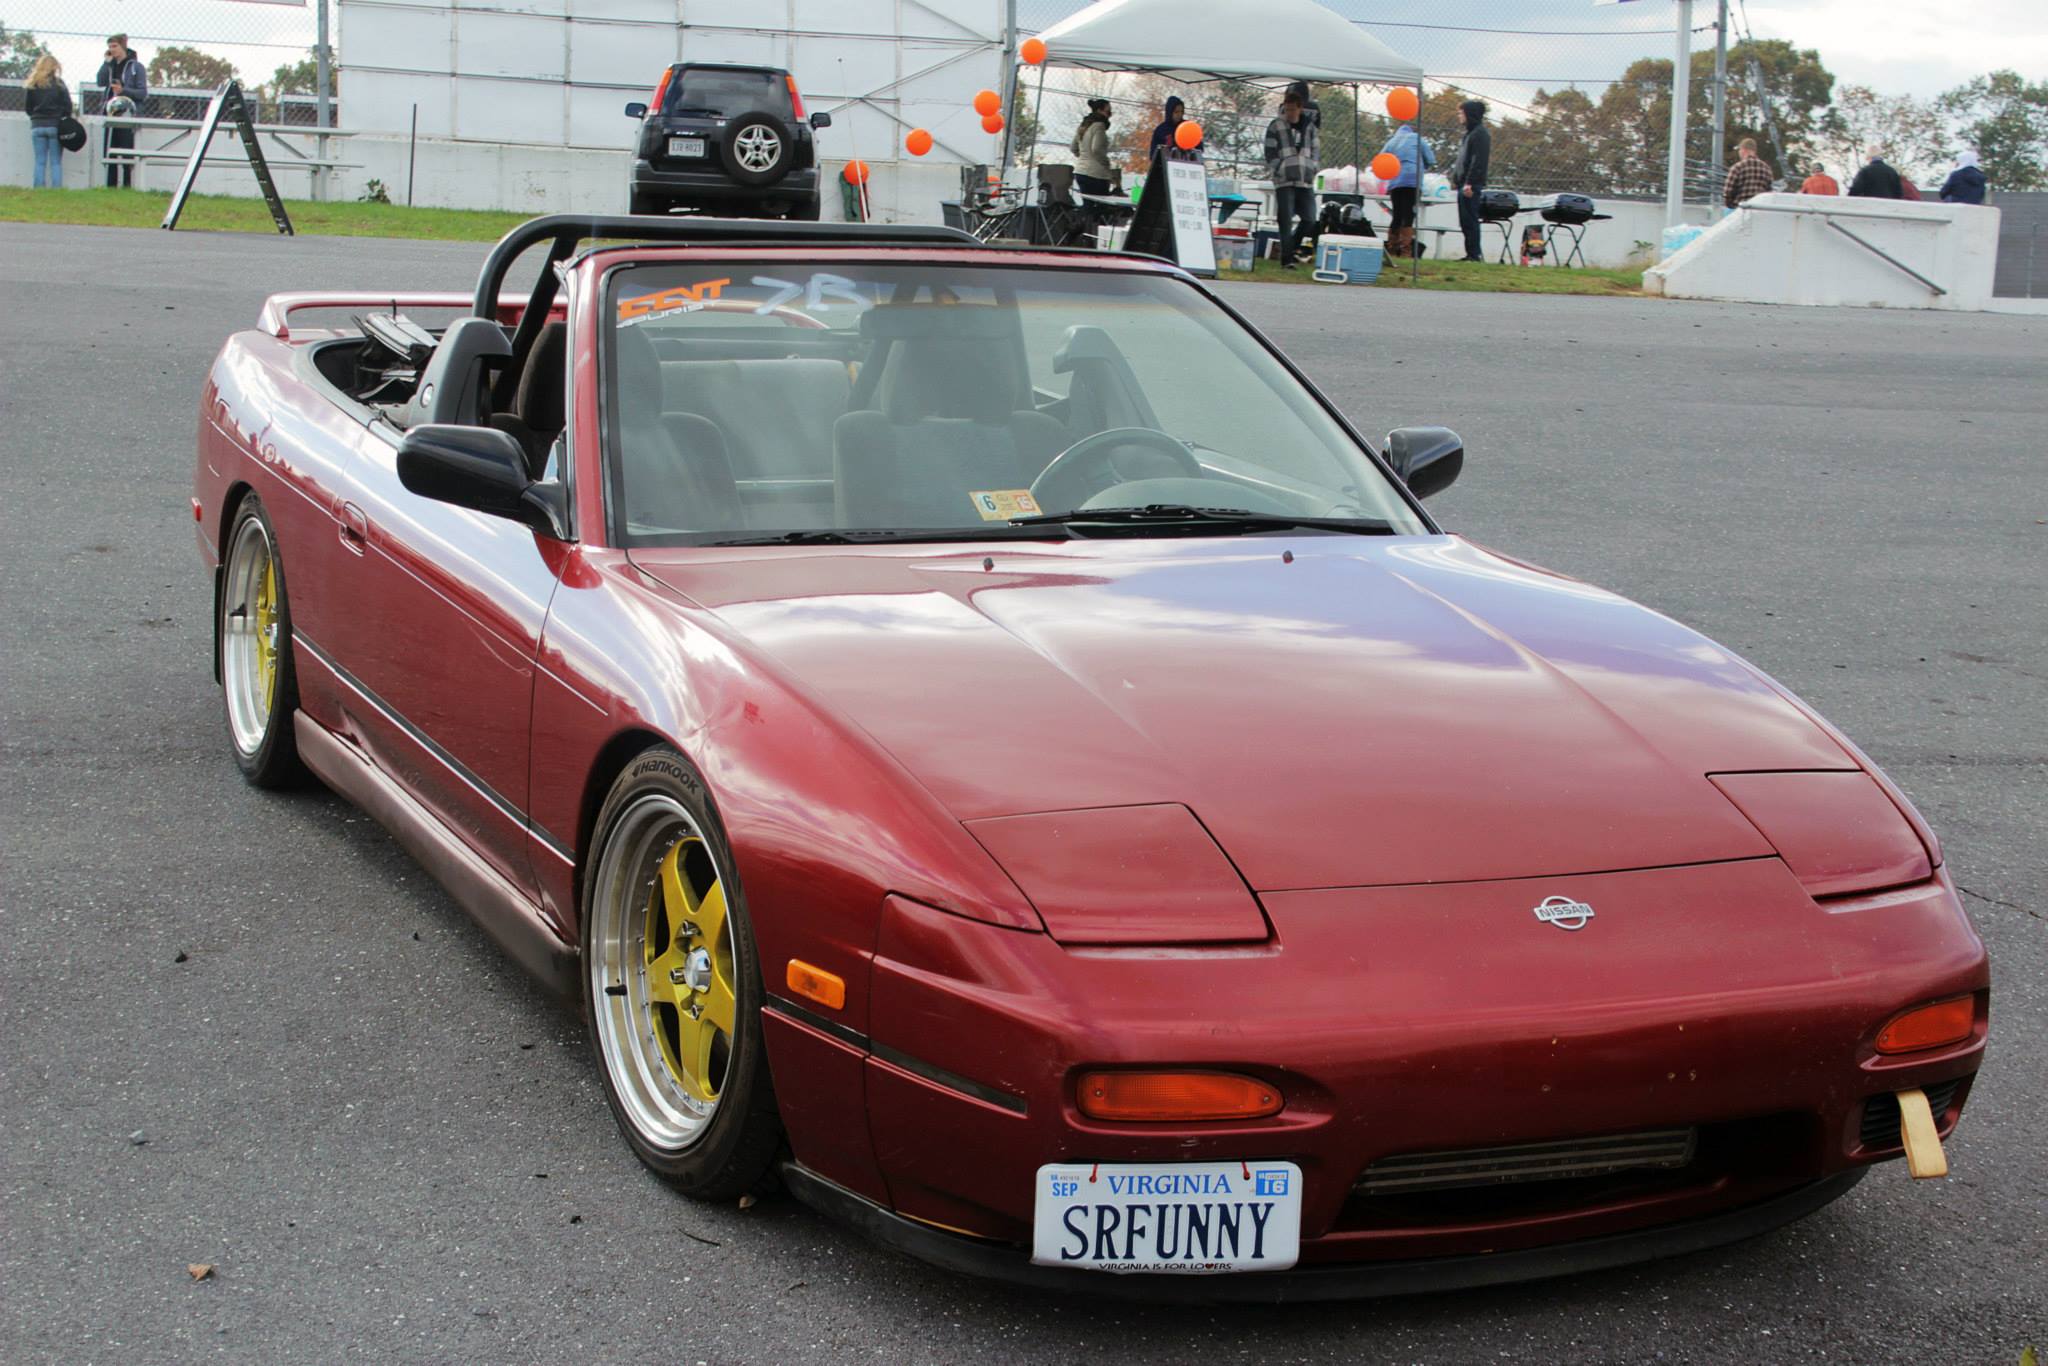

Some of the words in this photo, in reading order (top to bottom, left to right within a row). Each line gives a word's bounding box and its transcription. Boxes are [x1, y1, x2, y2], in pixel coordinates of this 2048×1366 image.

[983, 495, 996, 510] 6
[1539, 904, 1590, 917] NISSAN
[1052, 1182, 1078, 1197] SEP
[1107, 1174, 1232, 1195] VIRGINIA
[1264, 1180, 1285, 1195] 16
[1061, 1202, 1275, 1260] SRFUNNY
